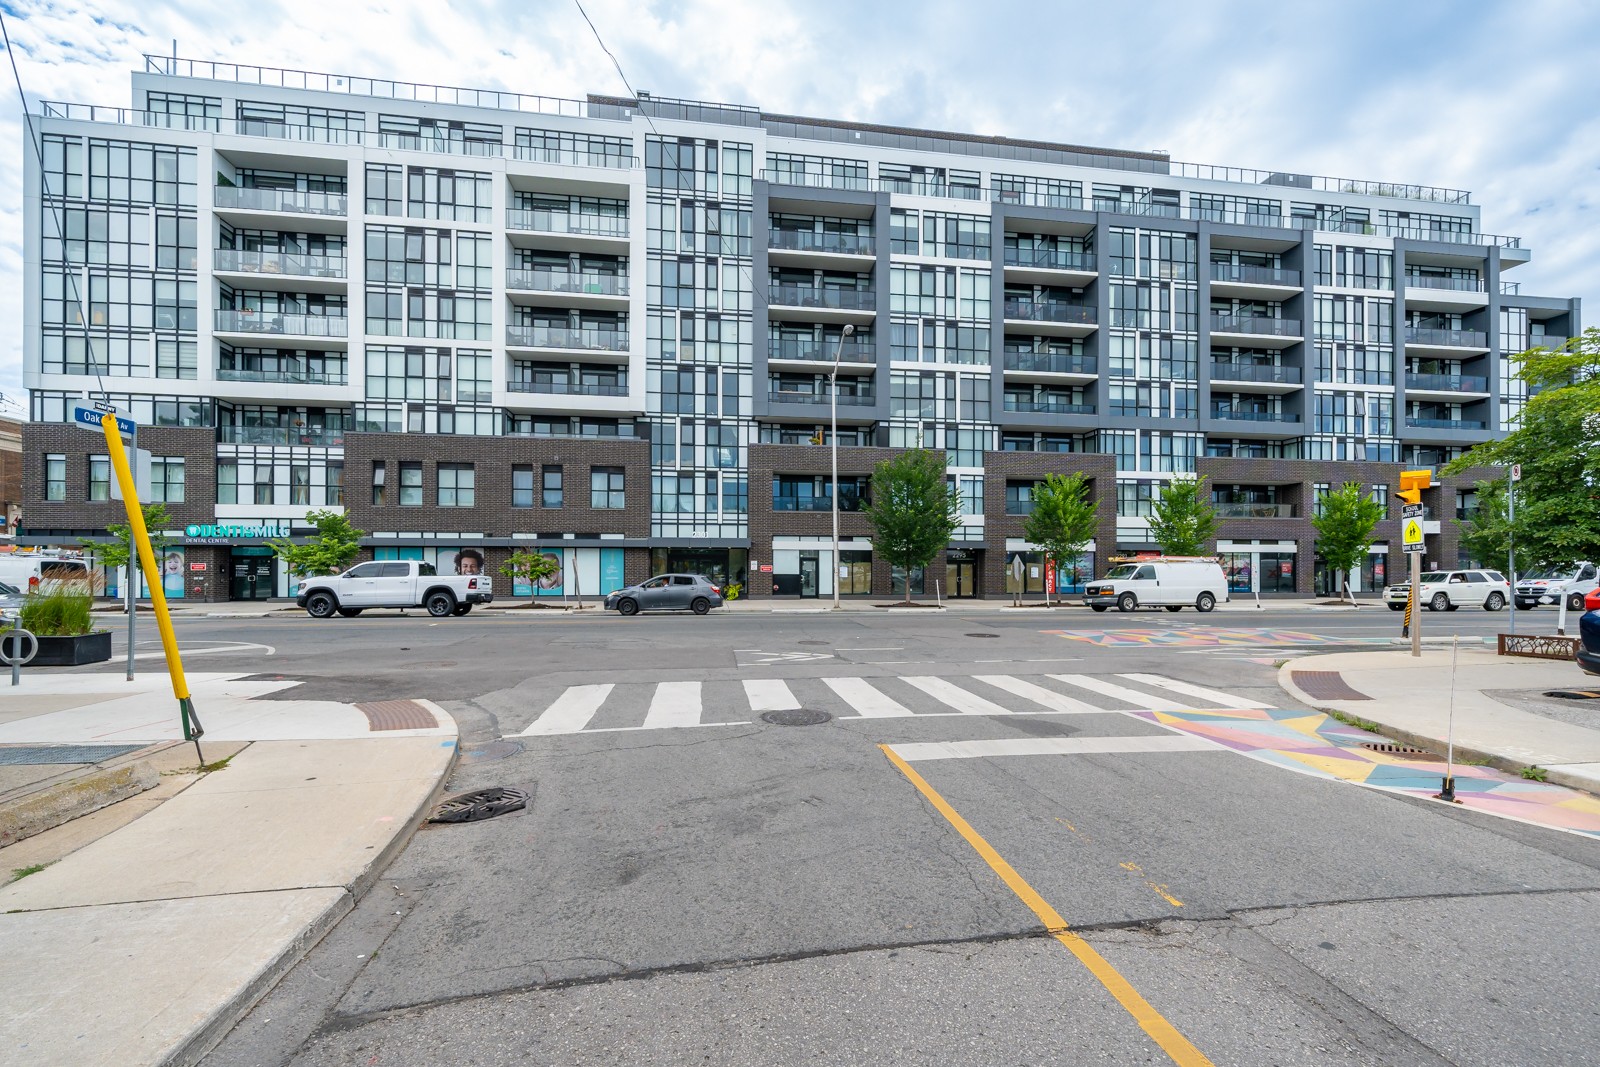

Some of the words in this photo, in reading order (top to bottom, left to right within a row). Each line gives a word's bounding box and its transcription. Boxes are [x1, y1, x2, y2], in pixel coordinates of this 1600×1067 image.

[84, 411, 100, 423] Oak
[120, 422, 129, 430] Av
[200, 524, 290, 538] DENTISMILE
